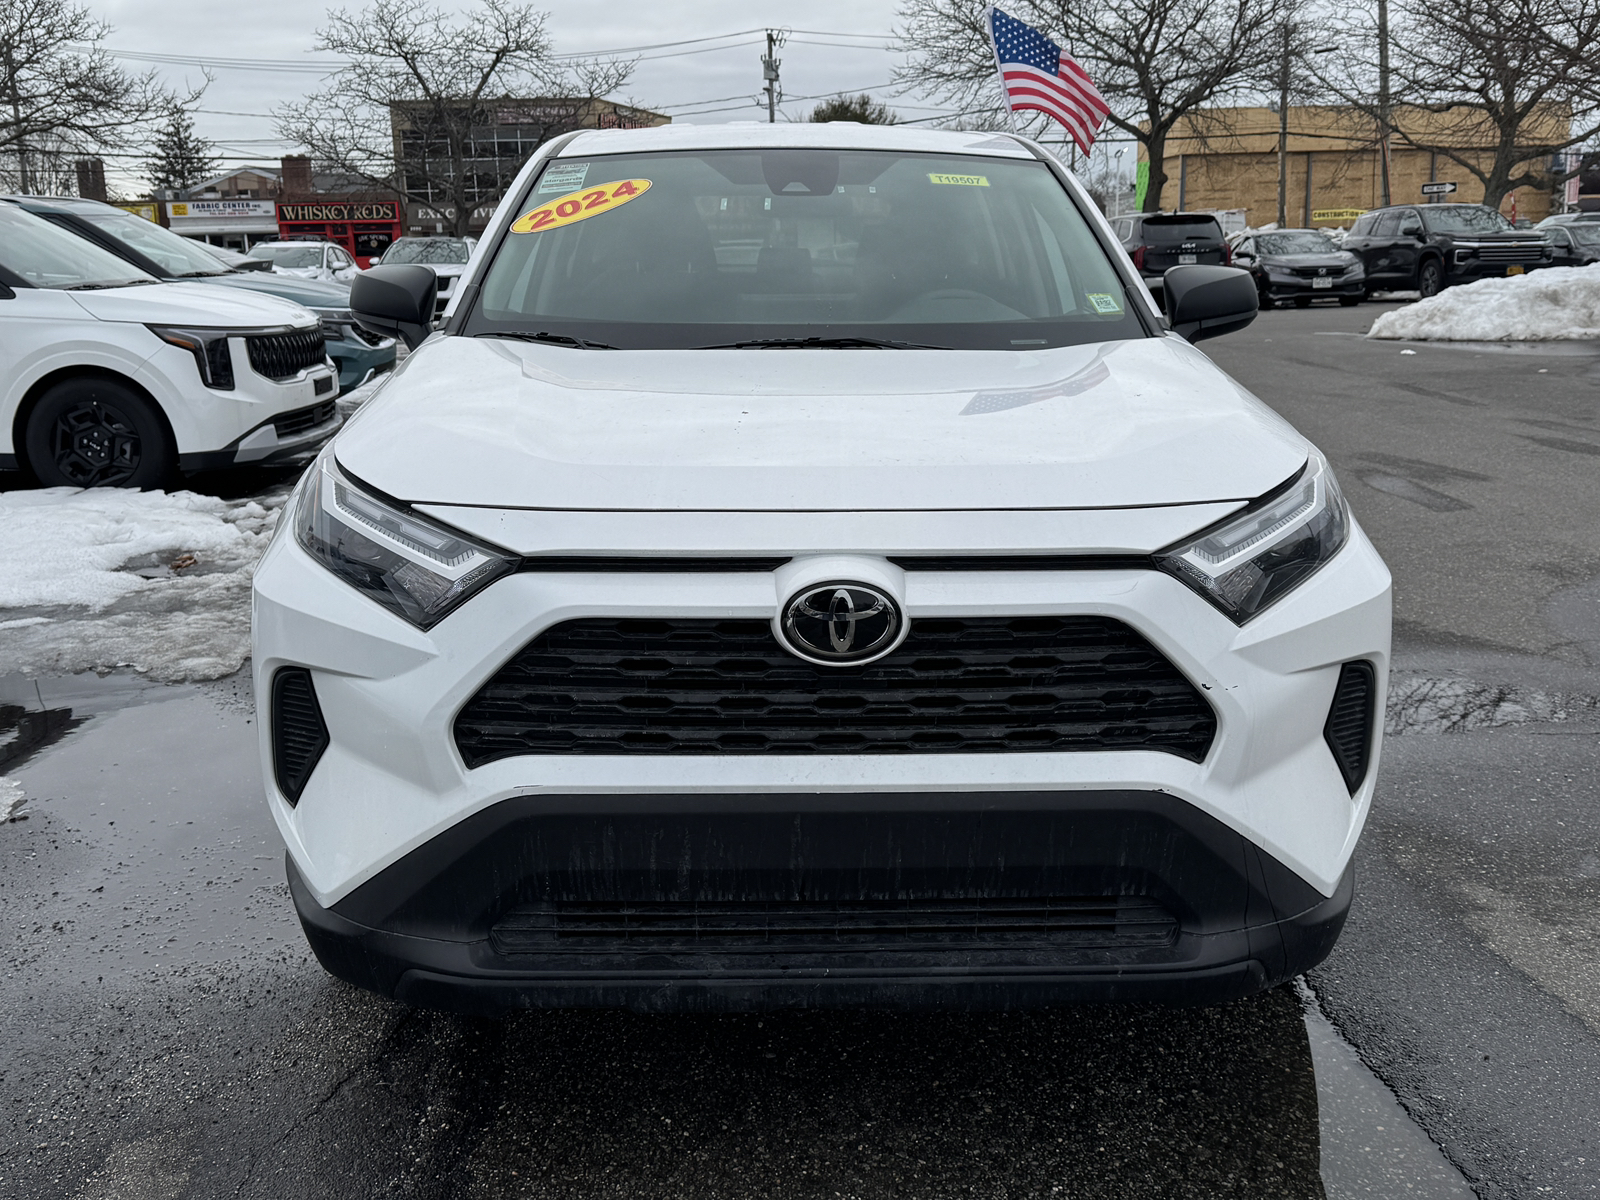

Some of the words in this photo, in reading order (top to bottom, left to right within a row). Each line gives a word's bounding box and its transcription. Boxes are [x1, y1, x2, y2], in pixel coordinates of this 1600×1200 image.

[935, 175, 980, 184] T19507
[282, 205, 350, 219] WHISKEY
[354, 204, 393, 219] REDS
[528, 180, 639, 231] 2024
